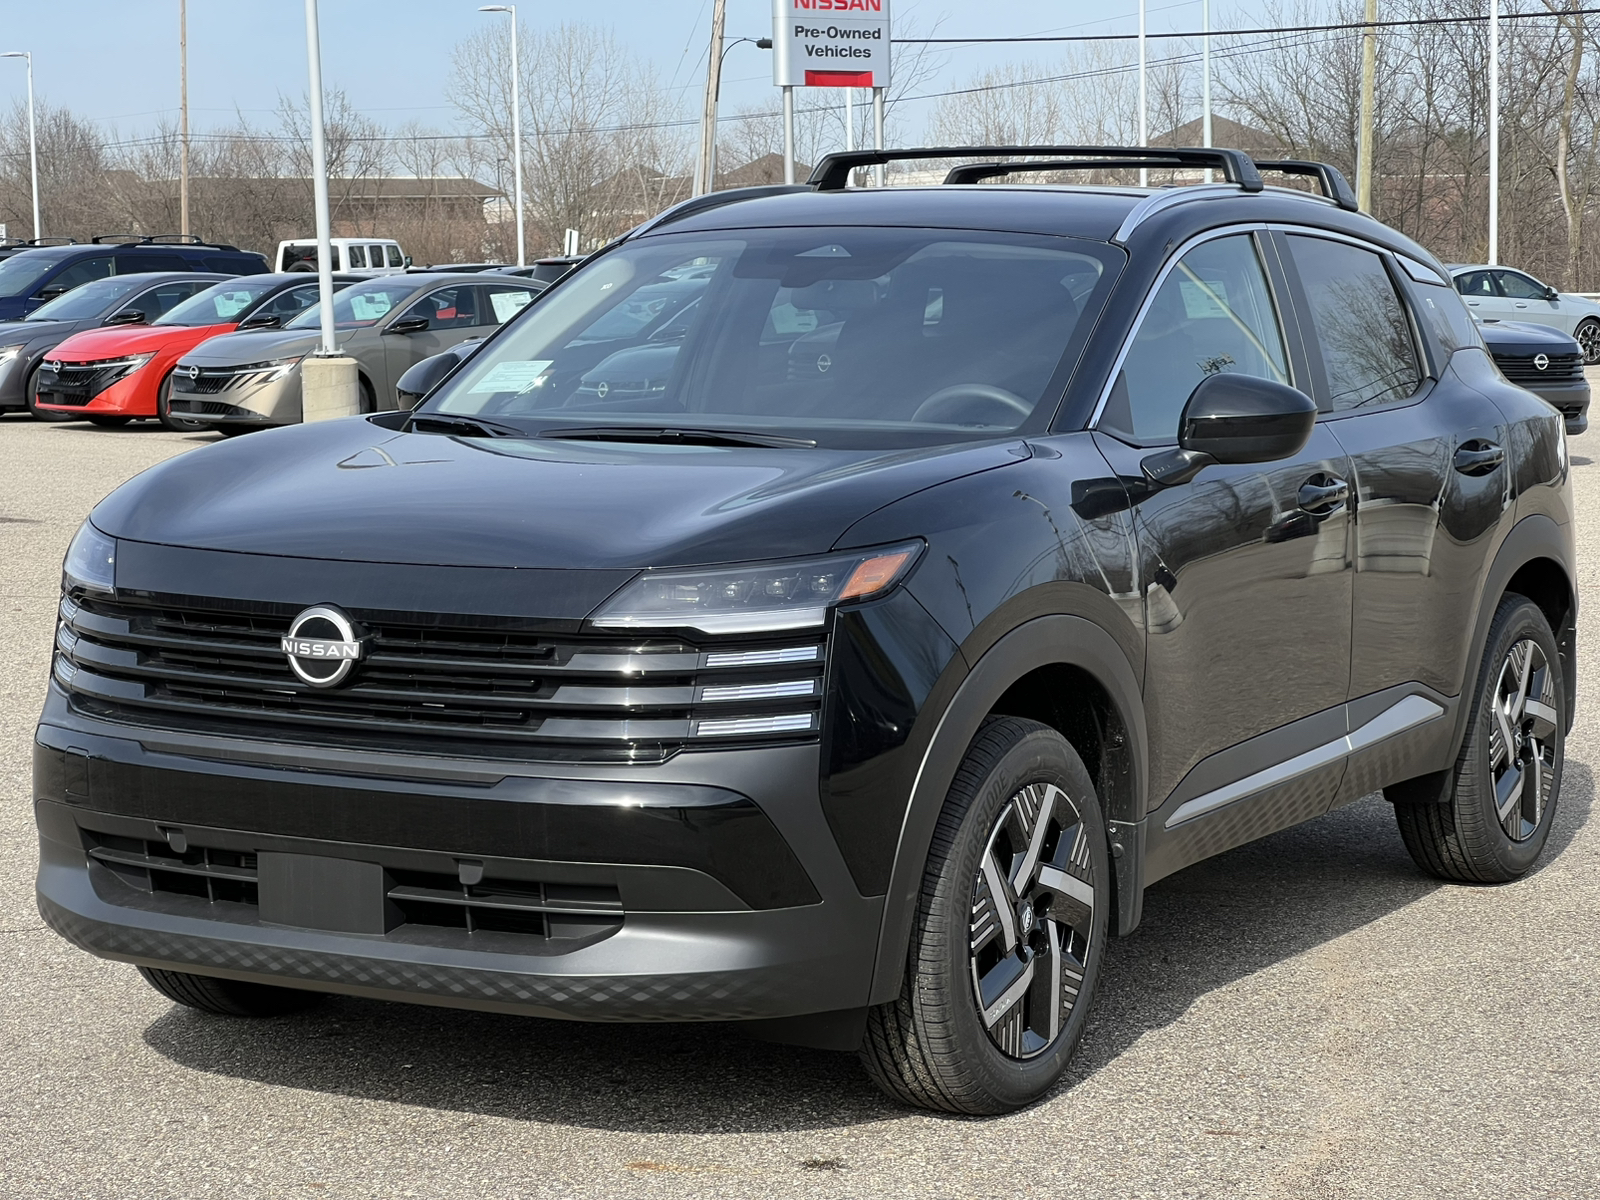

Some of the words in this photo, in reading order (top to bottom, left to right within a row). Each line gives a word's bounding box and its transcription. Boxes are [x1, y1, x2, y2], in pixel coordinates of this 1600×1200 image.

[794, 0, 881, 11] NISSAN
[794, 25, 881, 40] Pre-Owned
[805, 44, 872, 58] Vehicles
[282, 639, 357, 657] NISSAN
[952, 769, 1009, 919] BRIDGESTONE
